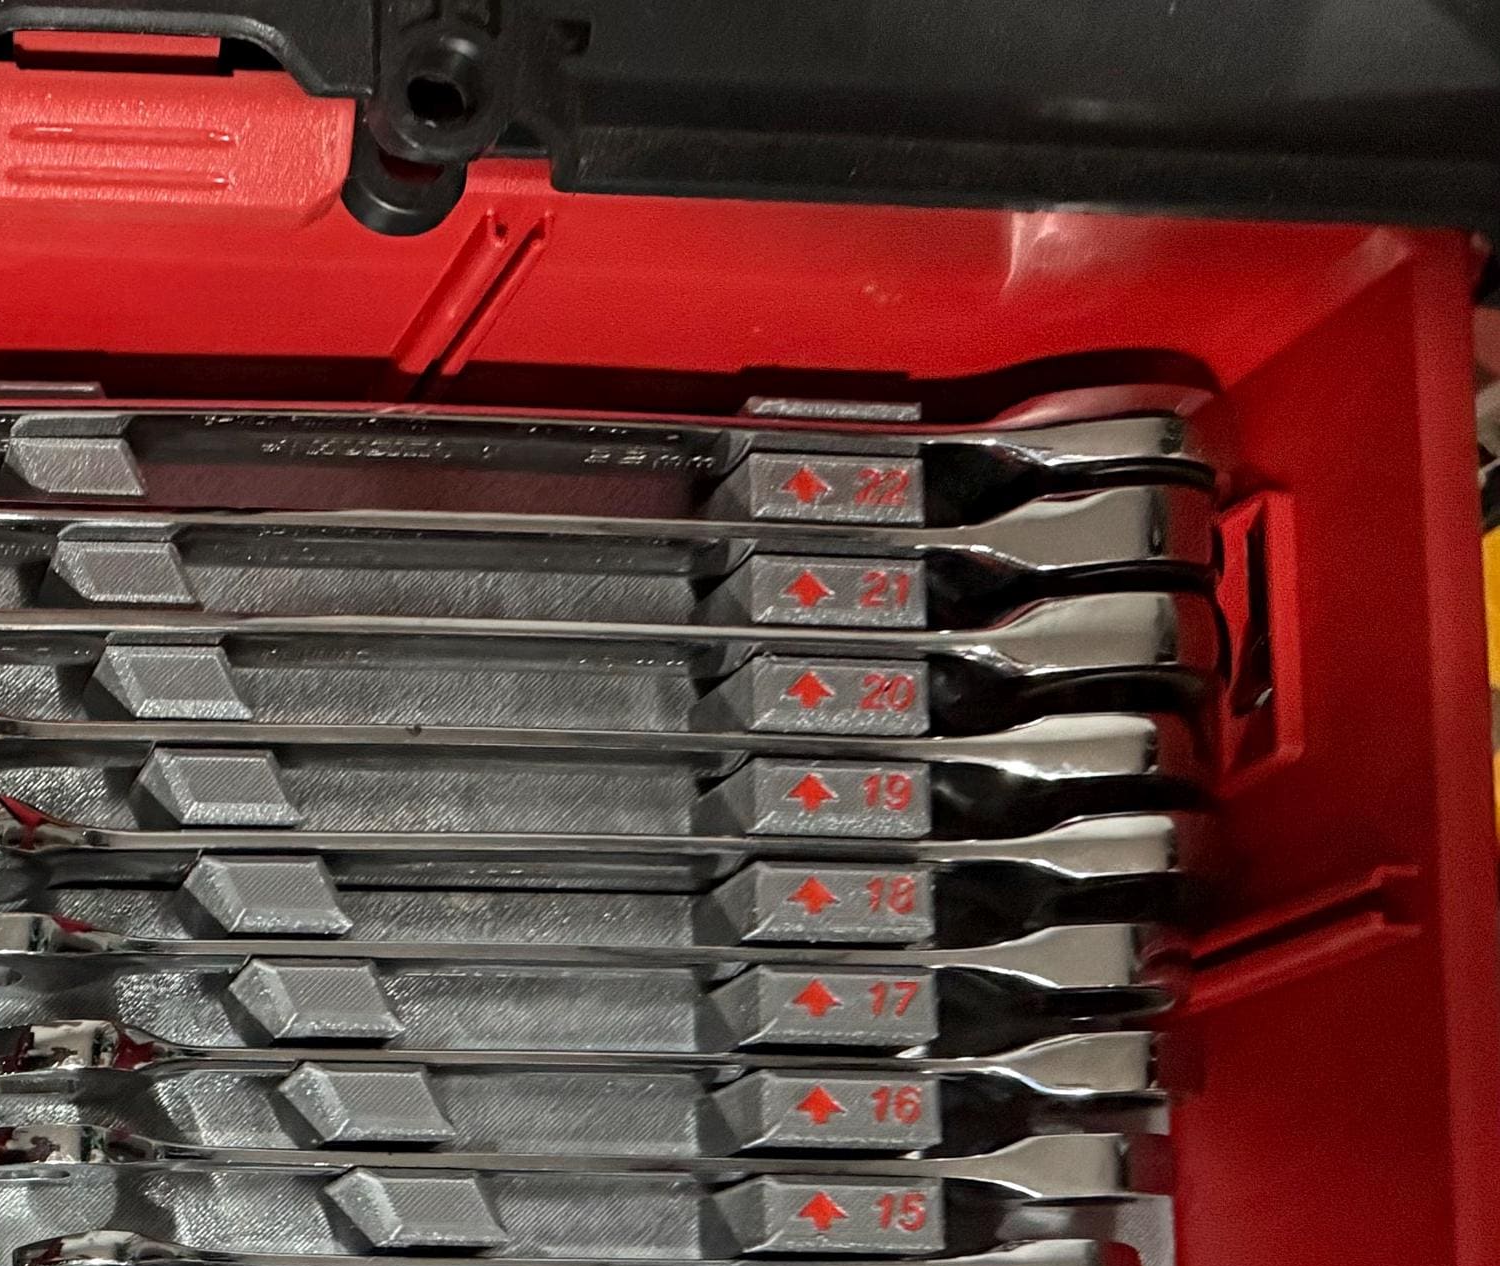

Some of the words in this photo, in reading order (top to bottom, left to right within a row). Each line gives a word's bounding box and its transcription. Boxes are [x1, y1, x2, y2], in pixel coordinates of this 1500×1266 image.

[854, 468, 911, 505] 22
[859, 571, 910, 607] 21
[858, 673, 916, 712] 20
[861, 774, 913, 811] 19
[865, 877, 916, 913] 18
[868, 981, 919, 1015] 17
[870, 1087, 922, 1123] 16
[876, 1193, 926, 1231] 15
